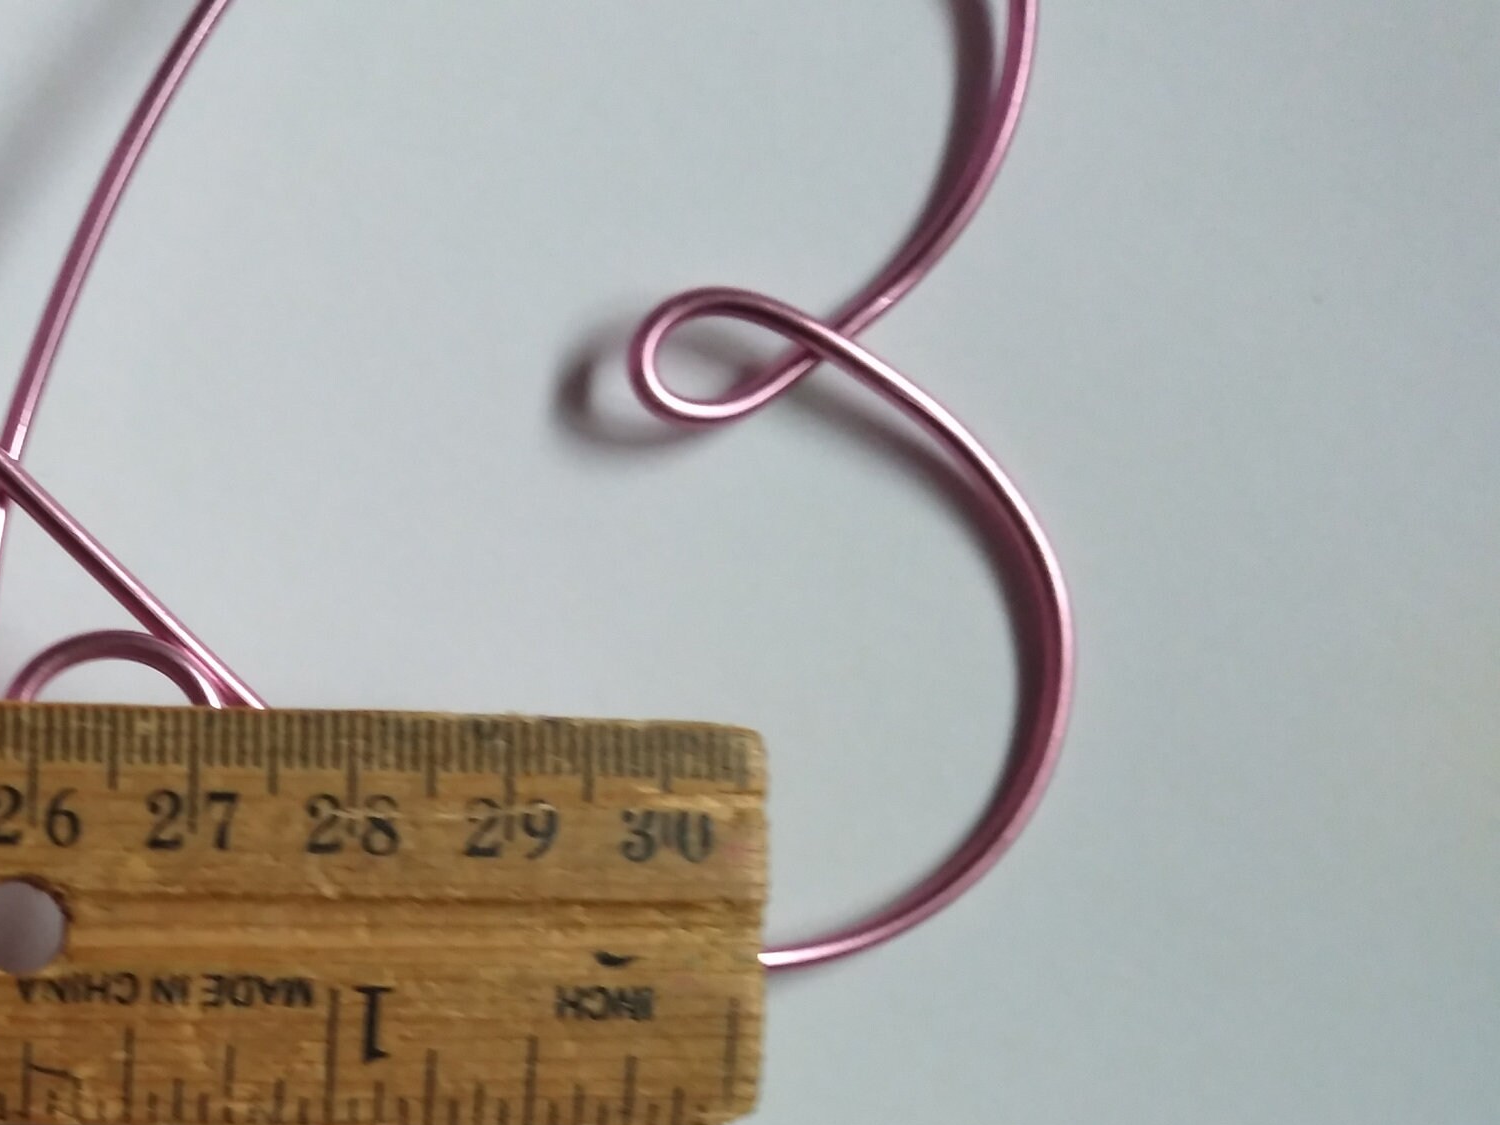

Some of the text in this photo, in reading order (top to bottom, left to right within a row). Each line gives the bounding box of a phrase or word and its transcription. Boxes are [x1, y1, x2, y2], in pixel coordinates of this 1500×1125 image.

[144, 789, 240, 851] 27
[305, 794, 399, 857] 28
[462, 799, 558, 860] 29
[618, 807, 713, 863] 30
[16, 970, 315, 1008] MADE IN CHINA
[353, 985, 394, 1063] 1
